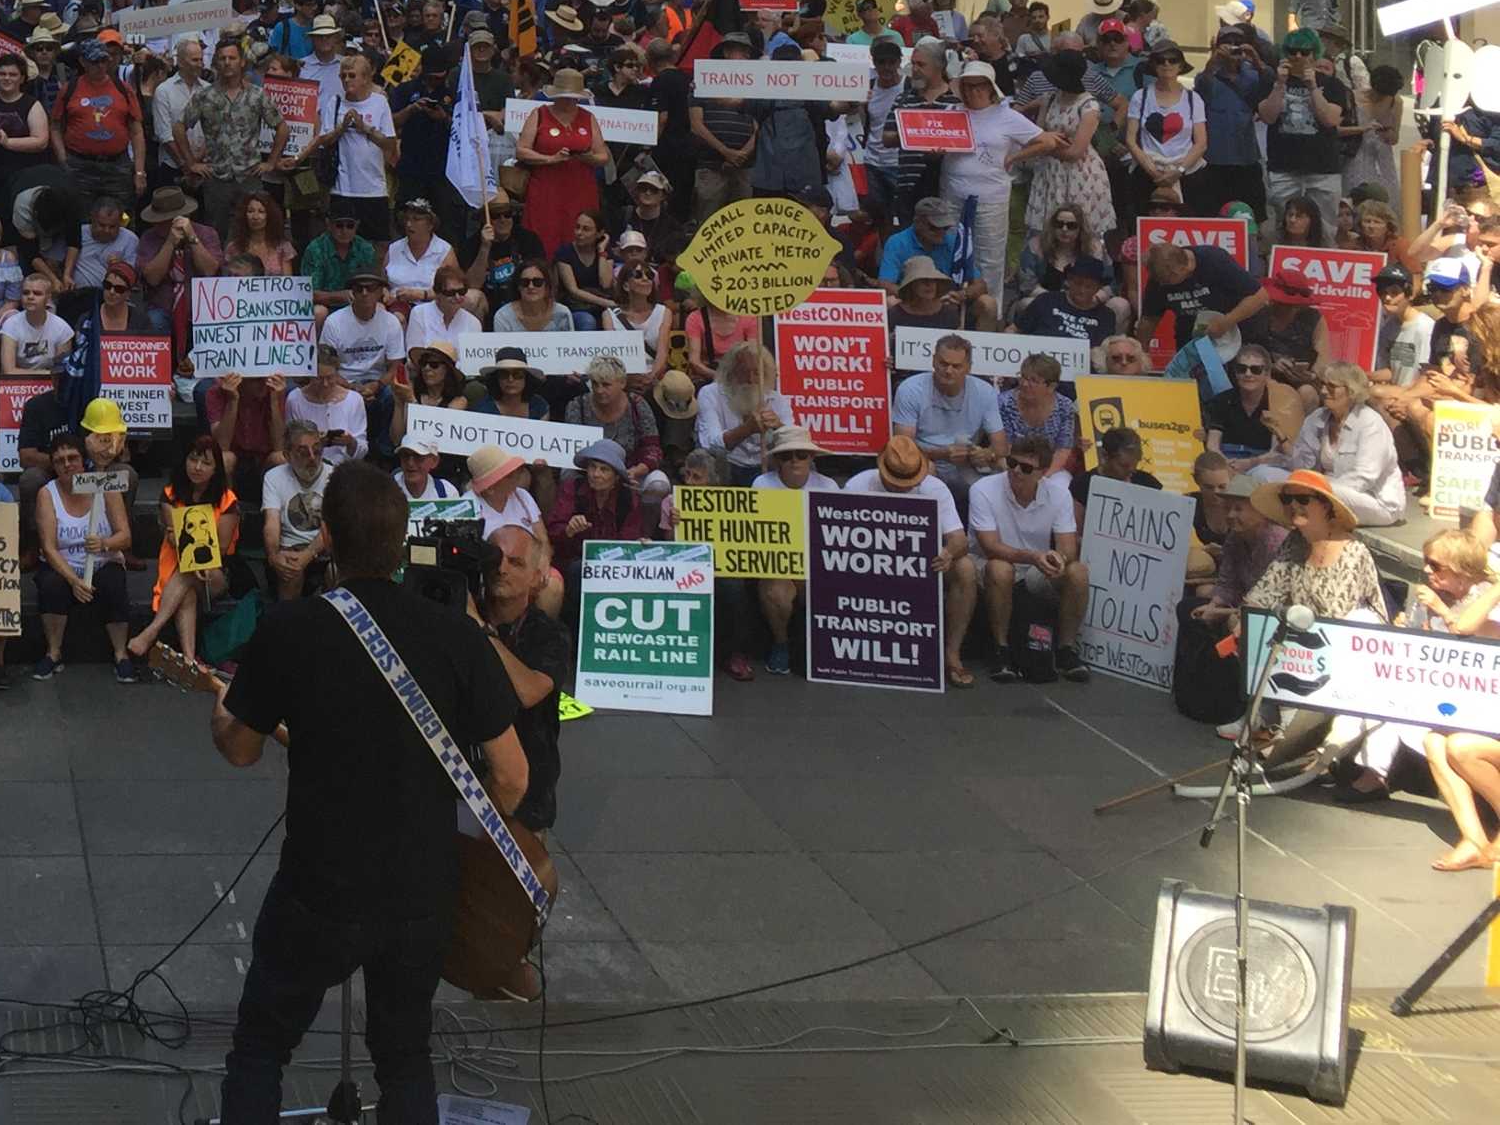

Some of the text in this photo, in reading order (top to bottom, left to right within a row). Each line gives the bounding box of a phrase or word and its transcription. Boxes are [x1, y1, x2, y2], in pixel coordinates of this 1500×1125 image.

[123, 18, 148, 32] STAGE
[156, 15, 174, 27] CAN
[187, 8, 229, 22] STOPPED!
[700, 72, 864, 88] TRAINS NOT TOLLS!
[270, 92, 308, 105] WON'T
[907, 128, 968, 138] WESTCONNEX
[926, 119, 943, 128] FIX
[701, 203, 804, 242] SMALL GAUGE
[693, 222, 819, 264] LIMITED CAPACITY
[711, 246, 764, 272] PRIVATE
[236, 277, 294, 292] METRO
[762, 274, 813, 289] BILLION
[236, 298, 315, 319] BANKSTOWN
[725, 293, 796, 315] WASTED
[778, 306, 884, 324] WestCONnex
[195, 321, 315, 345] INVEST IN NEW
[556, 346, 639, 358] TRANSPORT!!!
[792, 335, 871, 354] WON'T
[981, 346, 1022, 364] TOO
[107, 352, 158, 364] WON'T
[193, 347, 246, 370] TRAIN
[793, 354, 872, 373] WORK!
[108, 365, 157, 378] WORK
[101, 388, 165, 399] THE INNER
[803, 378, 865, 392] PUBLIC
[117, 401, 150, 412] WEST
[789, 395, 885, 410] TRANSPORT
[158, 413, 169, 424] IT
[799, 413, 873, 435] WILL!
[450, 425, 489, 444] NOT
[494, 430, 535, 450] TOO
[681, 489, 759, 514] RESTORE
[816, 506, 930, 526] WestCONnex
[1092, 493, 1180, 551] TRAINS
[680, 518, 791, 545] THE HUNTER
[821, 525, 927, 553] WON'T
[726, 549, 804, 576] SERVICE!
[821, 550, 928, 578] WORK!
[1108, 548, 1163, 591] NOT
[583, 565, 706, 591] BEREJIKLIAN HAS
[594, 597, 702, 632] CUT
[837, 595, 912, 616] PUBLIC
[1084, 583, 1162, 643] TOLLS
[814, 614, 936, 638] TRANSPORT
[594, 632, 699, 648] NEWCASTLE
[594, 648, 699, 665] RAIL LINE
[831, 636, 920, 666] WILL!
[1282, 648, 1314, 661] YOUR
[1419, 644, 1486, 669] SUPER
[342, 601, 443, 740] CRIME SCENE
[1281, 661, 1315, 676] TOLLS
